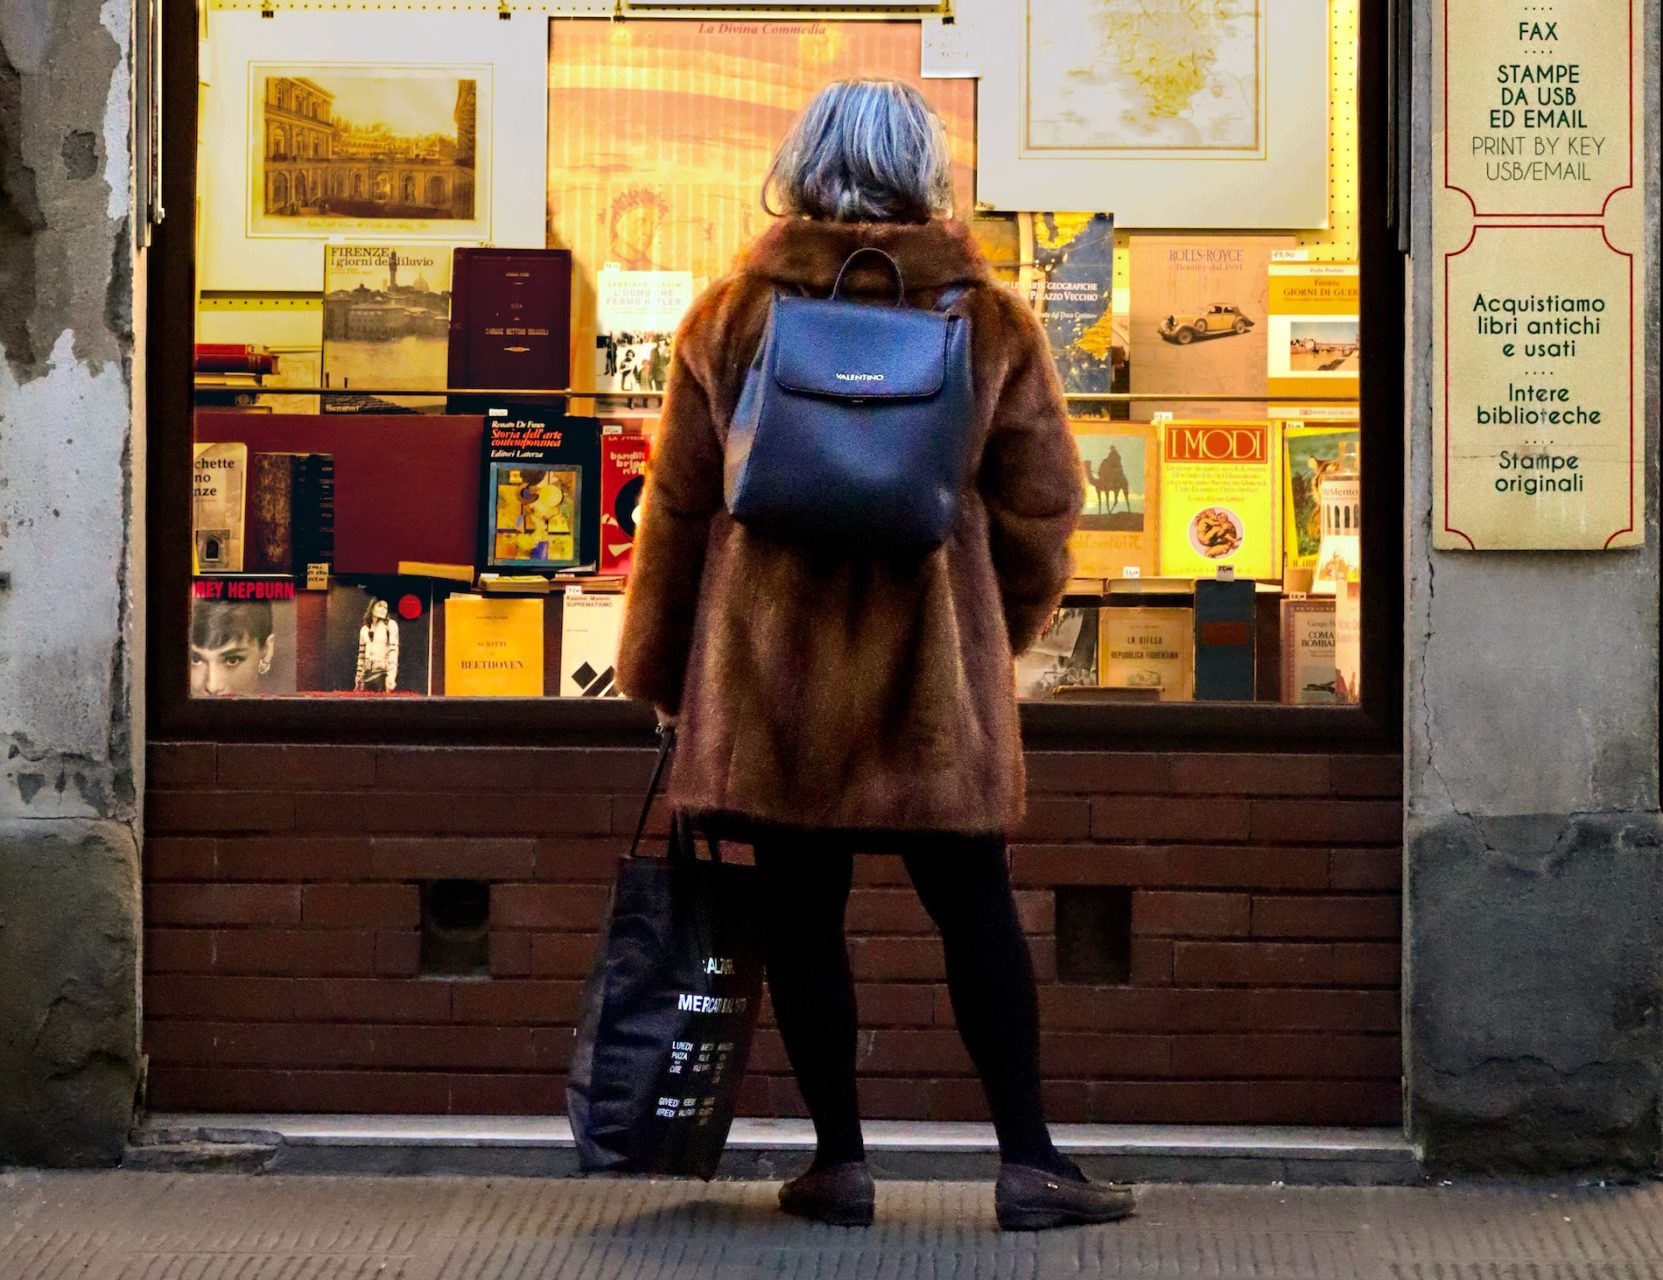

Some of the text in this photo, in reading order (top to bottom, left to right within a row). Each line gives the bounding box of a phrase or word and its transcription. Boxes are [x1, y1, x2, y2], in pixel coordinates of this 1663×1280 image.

[698, 22, 826, 36] La Divina Commedia
[1519, 22, 1558, 41] FAX
[1497, 65, 1580, 84] STAMPE
[1501, 87, 1577, 106] DA USB
[1490, 109, 1588, 129] ED EMAIL
[1472, 136, 1606, 156] PRINT BY KEY
[1486, 162, 1592, 181] USB/EMAIL
[331, 247, 389, 257] FIRENZE
[1169, 248, 1244, 262] ROLLS-ROYCE
[336, 257, 373, 269] giorni
[1047, 282, 1098, 291] GEOGRAFICHE
[1283, 288, 1318, 297] GIORNI
[1320, 288, 1332, 297] DI
[1064, 292, 1098, 302] VECCHIO
[1473, 294, 1606, 316] Acquistiamo
[1478, 317, 1601, 336] libri antichi
[1502, 340, 1576, 357] e usati
[836, 373, 884, 381] VALENTINO
[1509, 383, 1570, 402] Intere
[1477, 406, 1601, 425] biblioteche
[491, 429, 520, 440] Storia
[1171, 429, 1262, 459] I MODI
[1499, 450, 1579, 473] Stampe
[1495, 474, 1584, 495] originali
[193, 581, 295, 600] REY HEPBURN
[461, 660, 524, 670] BEETHOVEN
